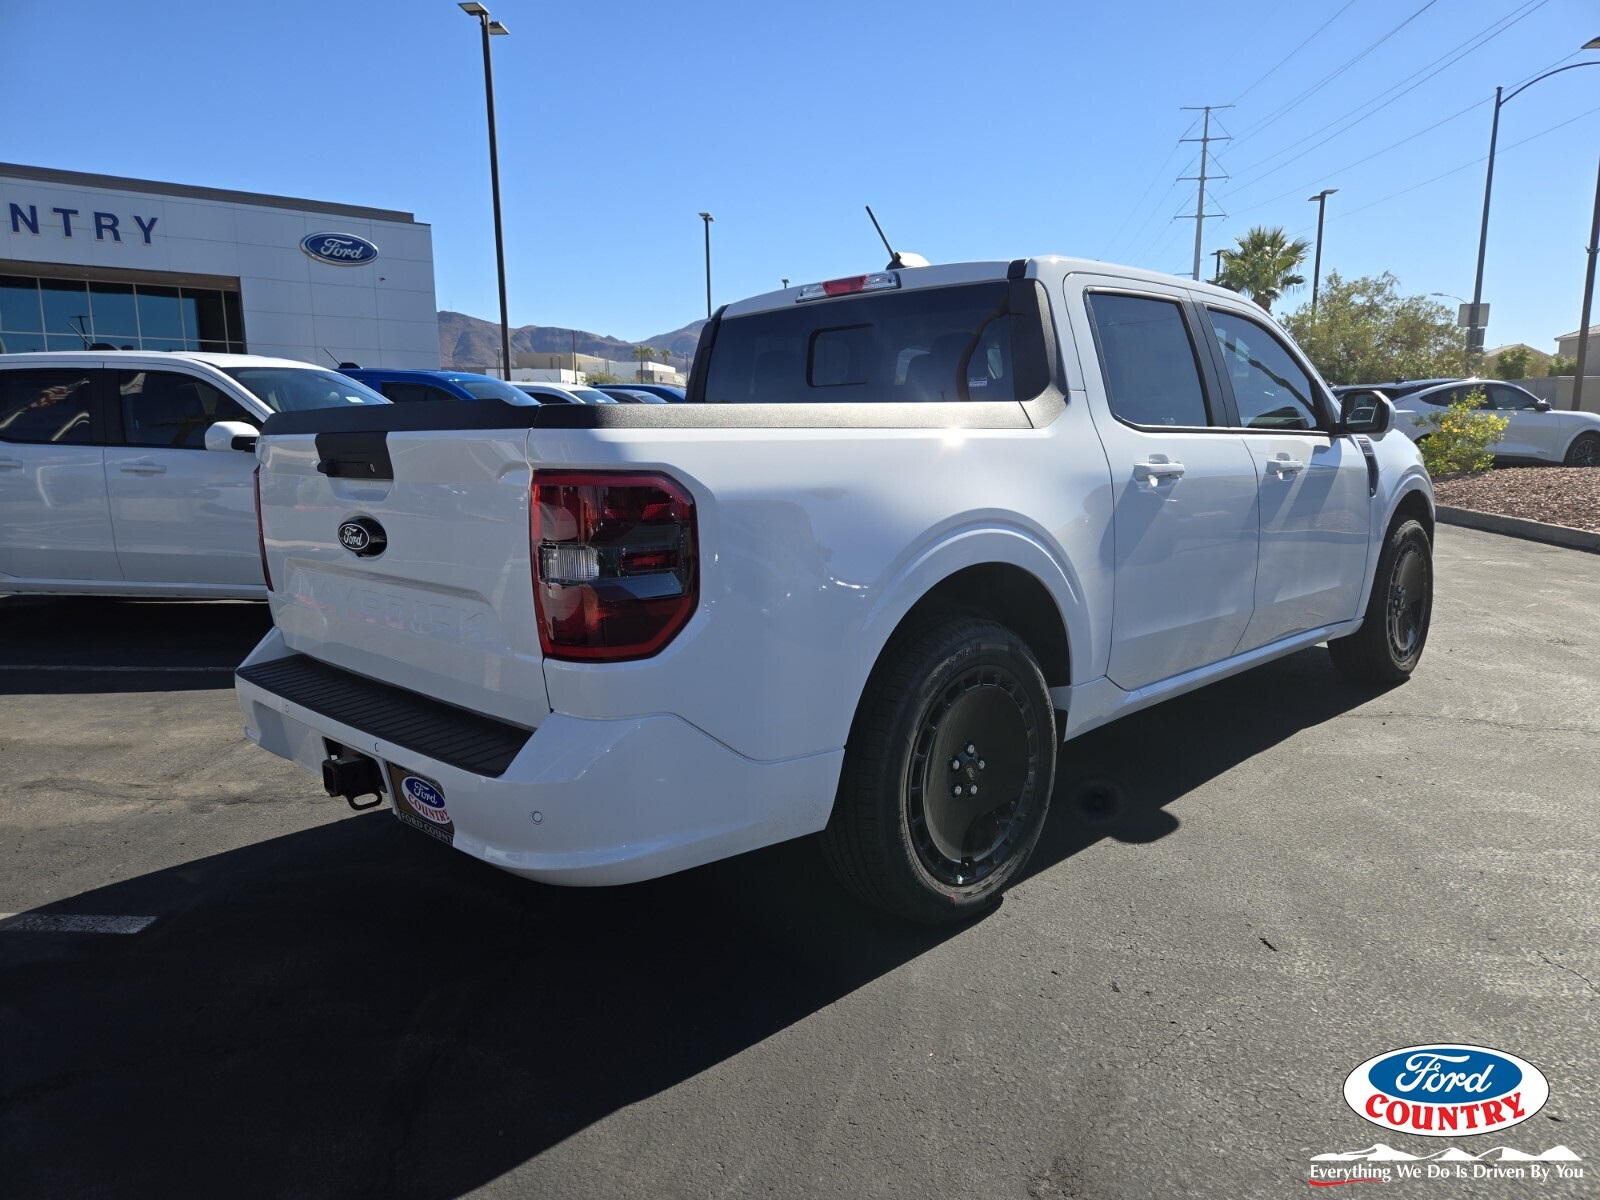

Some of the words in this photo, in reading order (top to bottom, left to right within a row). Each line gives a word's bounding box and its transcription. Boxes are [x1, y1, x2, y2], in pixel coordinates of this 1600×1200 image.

[10, 202, 158, 246] NTRY
[320, 237, 364, 261] Ford
[343, 526, 363, 546] Ford
[413, 781, 438, 805] Ford
[401, 813, 423, 829] FORD
